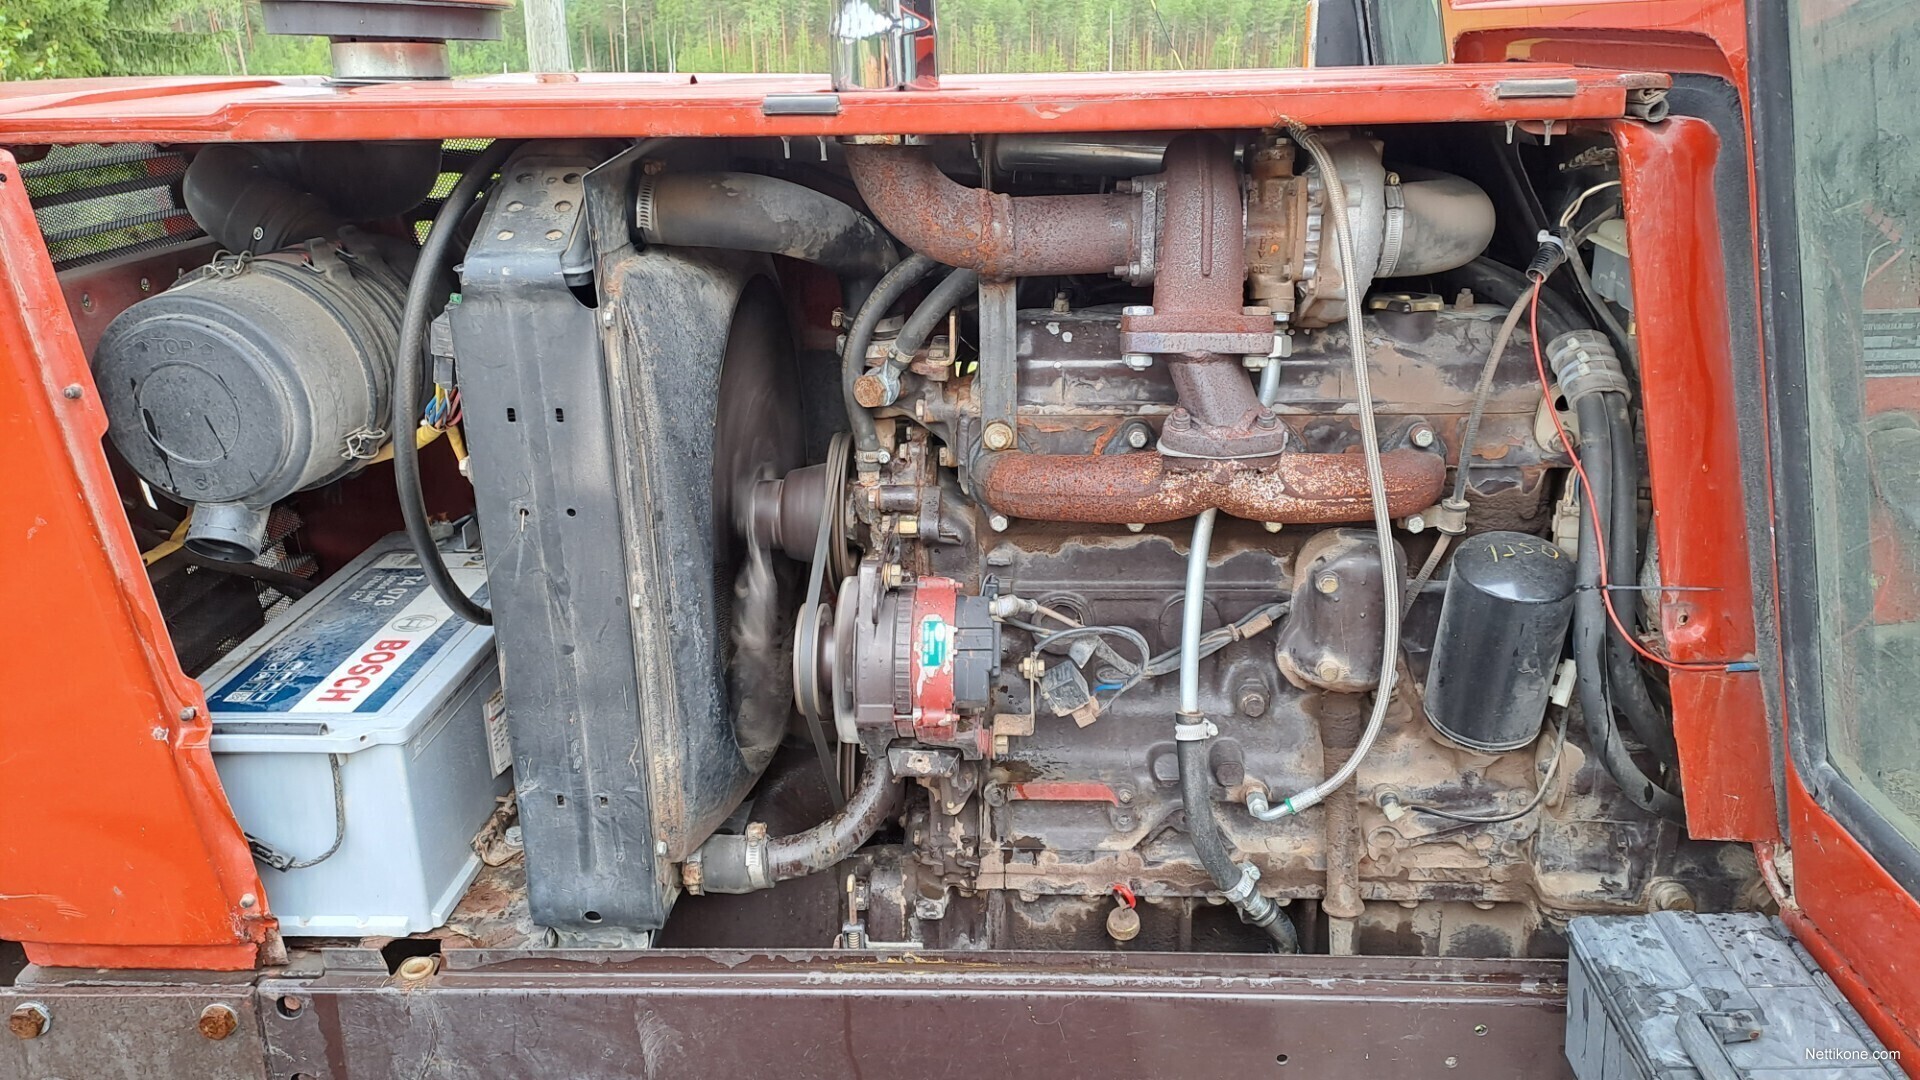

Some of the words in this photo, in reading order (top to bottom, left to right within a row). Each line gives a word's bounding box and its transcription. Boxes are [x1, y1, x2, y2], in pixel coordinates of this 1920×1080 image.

[150, 337, 195, 356] TOP
[397, 574, 425, 586] T4
[374, 588, 409, 606] 078
[316, 640, 411, 702] BOSCH
